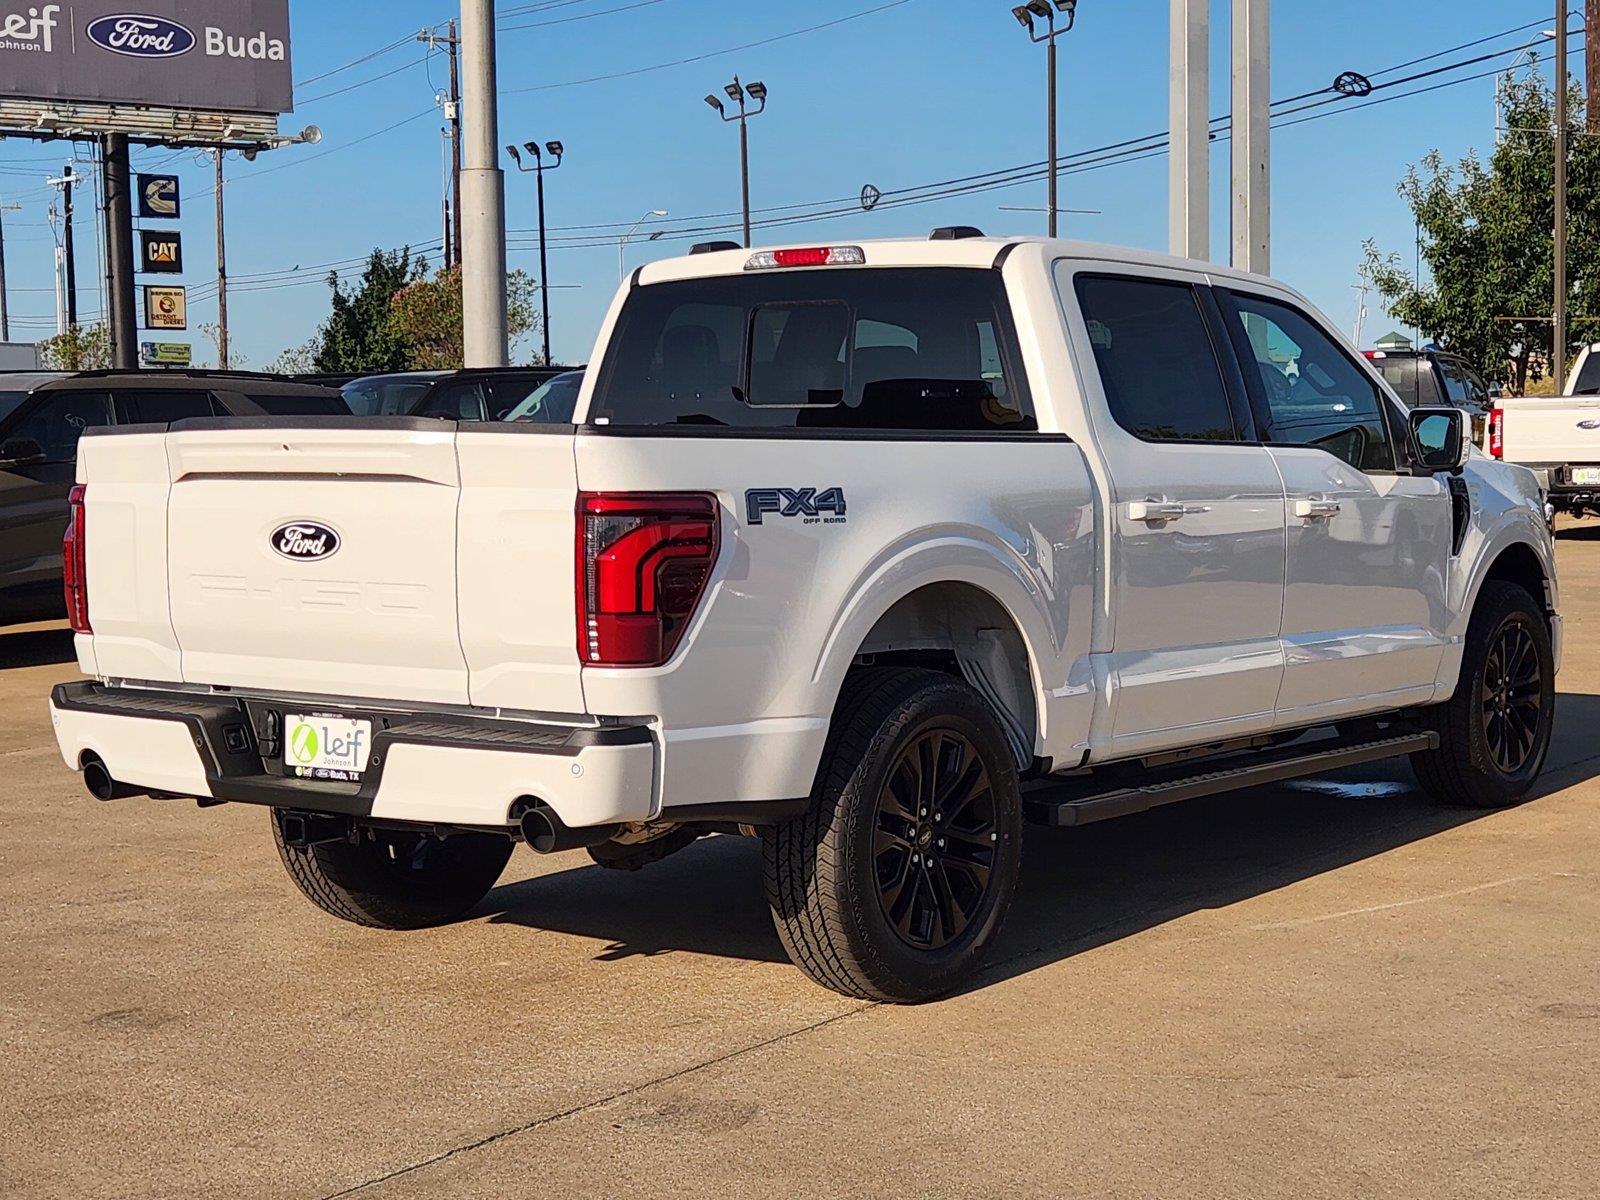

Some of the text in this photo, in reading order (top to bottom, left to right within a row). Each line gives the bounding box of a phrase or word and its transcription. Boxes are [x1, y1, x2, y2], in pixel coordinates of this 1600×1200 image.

[0, 4, 60, 52] eif
[108, 19, 285, 61] Ford Buda
[0, 40, 41, 52] ohnson
[149, 241, 178, 262] CAT
[744, 487, 847, 525] FX4
[803, 517, 821, 525] OFF
[280, 526, 327, 554] Ford
[322, 726, 365, 767] leif
[323, 757, 351, 766] Johnson
[349, 771, 359, 781] TX
